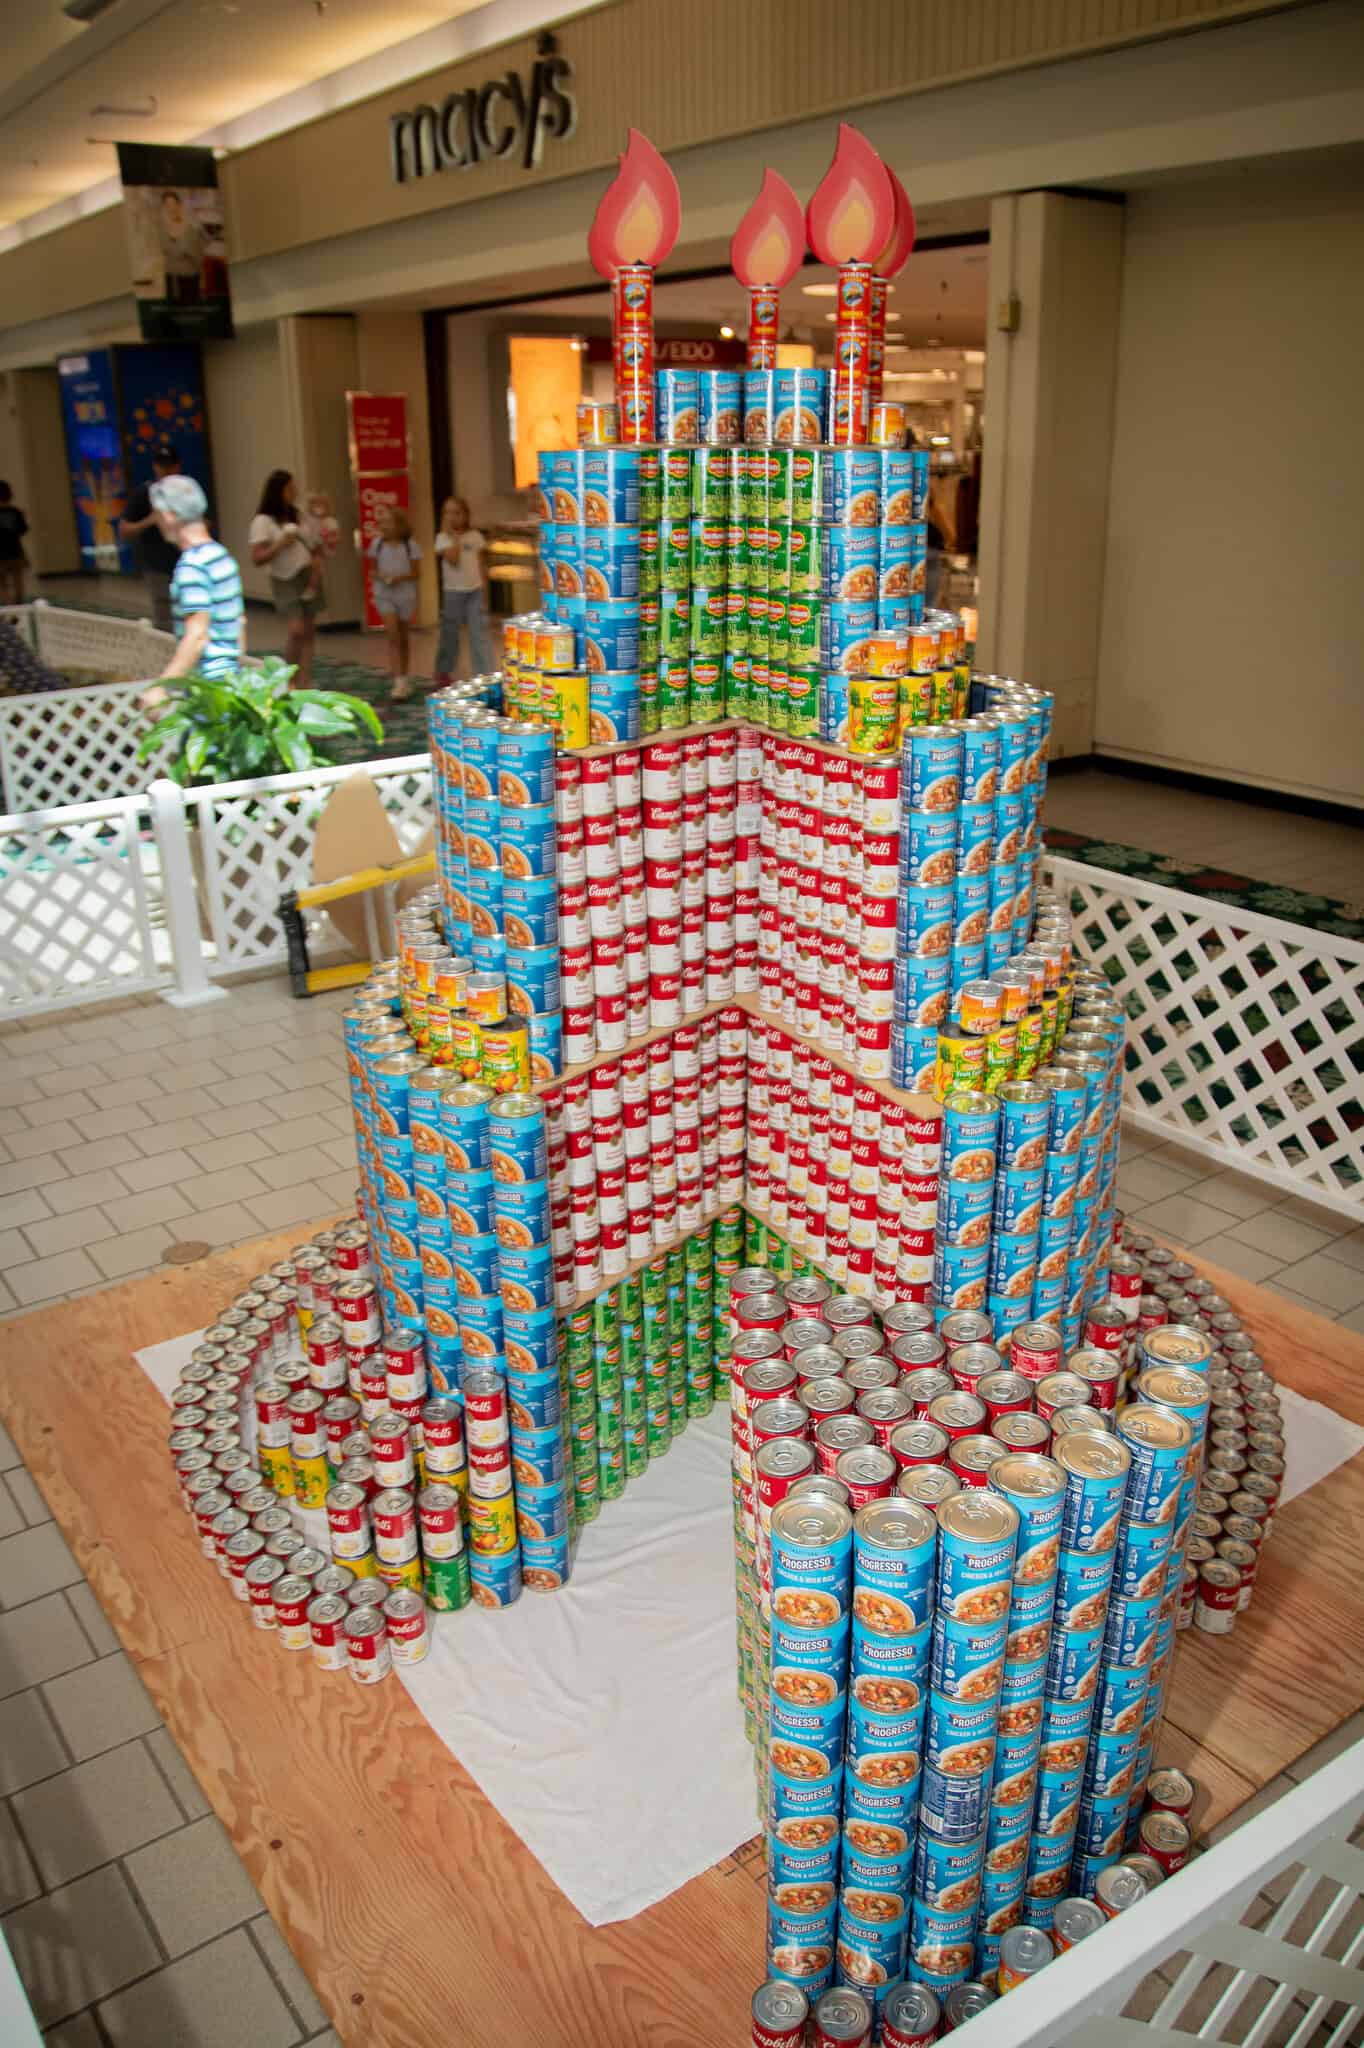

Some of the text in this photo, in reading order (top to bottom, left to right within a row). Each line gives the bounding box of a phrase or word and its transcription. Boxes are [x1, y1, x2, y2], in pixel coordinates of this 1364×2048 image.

[781, 1556, 831, 1571] PROGRESSO
[780, 1638, 828, 1652] PROGRESSO
[864, 1646, 913, 1659] PROGRESSO
[786, 1785, 833, 1802] PROGRESSO
